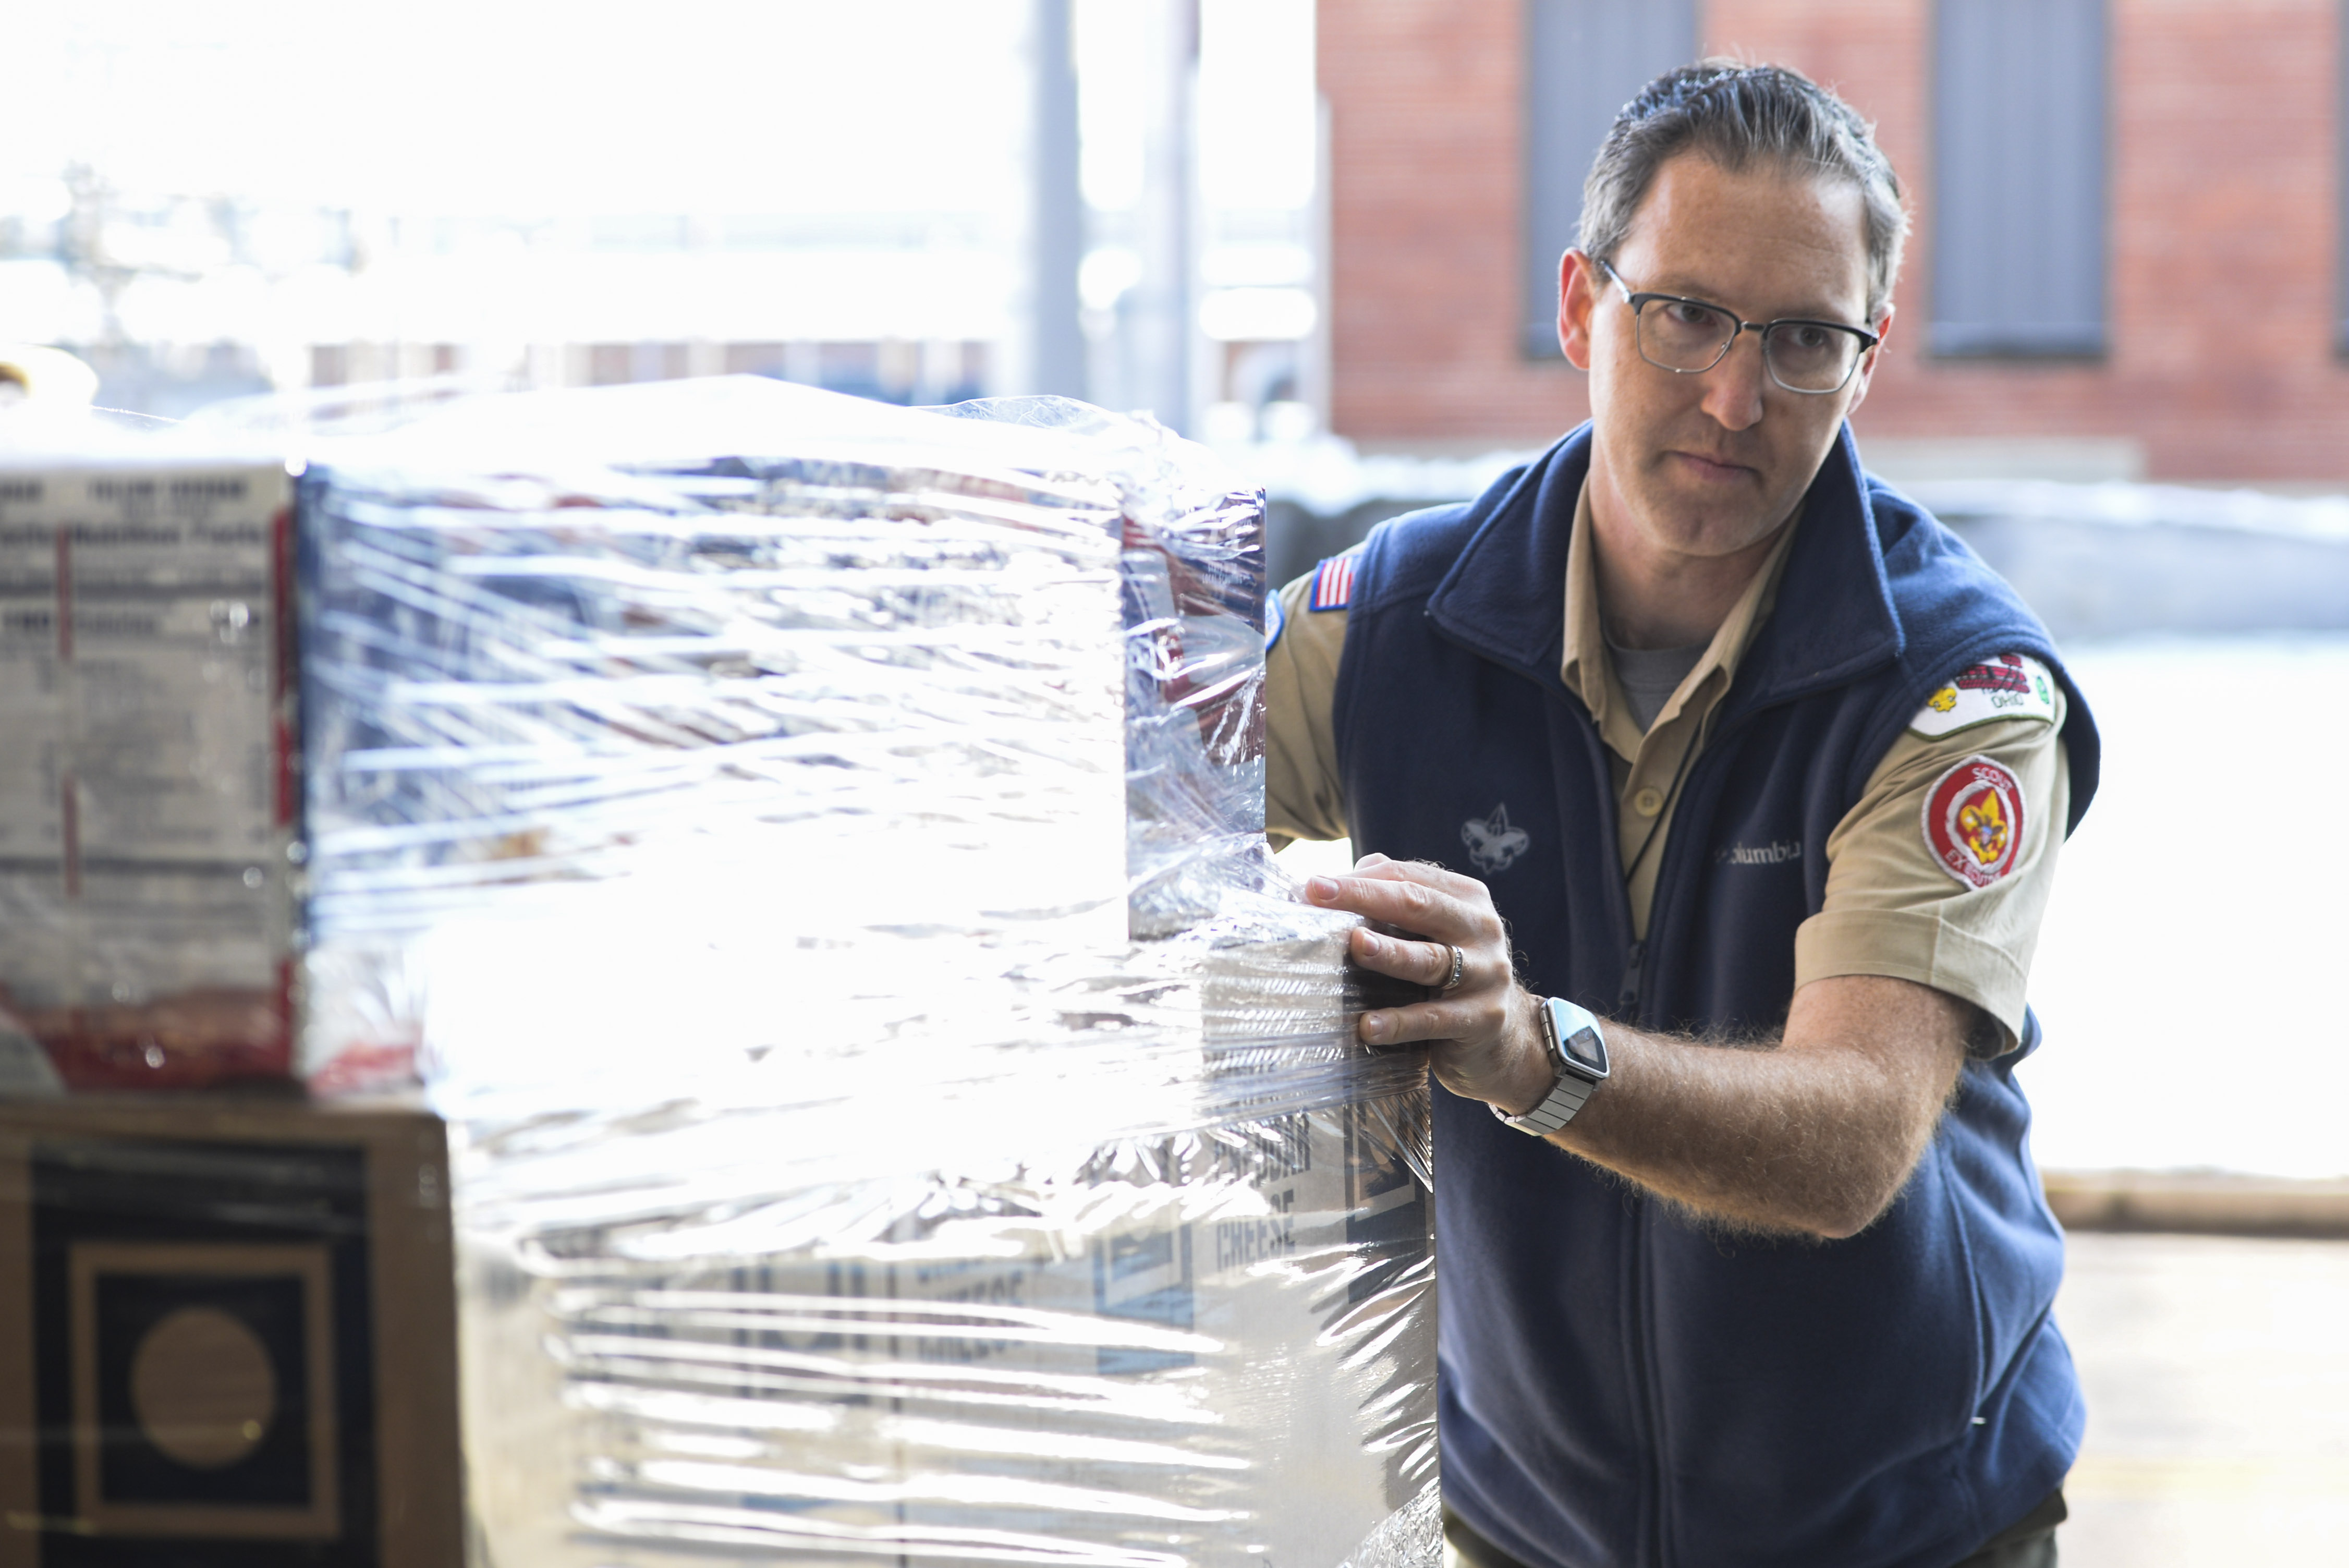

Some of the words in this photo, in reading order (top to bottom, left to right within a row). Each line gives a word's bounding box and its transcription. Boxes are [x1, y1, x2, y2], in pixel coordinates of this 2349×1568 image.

[1971, 767, 2013, 794] SCOUT
[1714, 840, 1802, 865] olumbu
[1216, 1188, 1296, 1272] CHEESE
